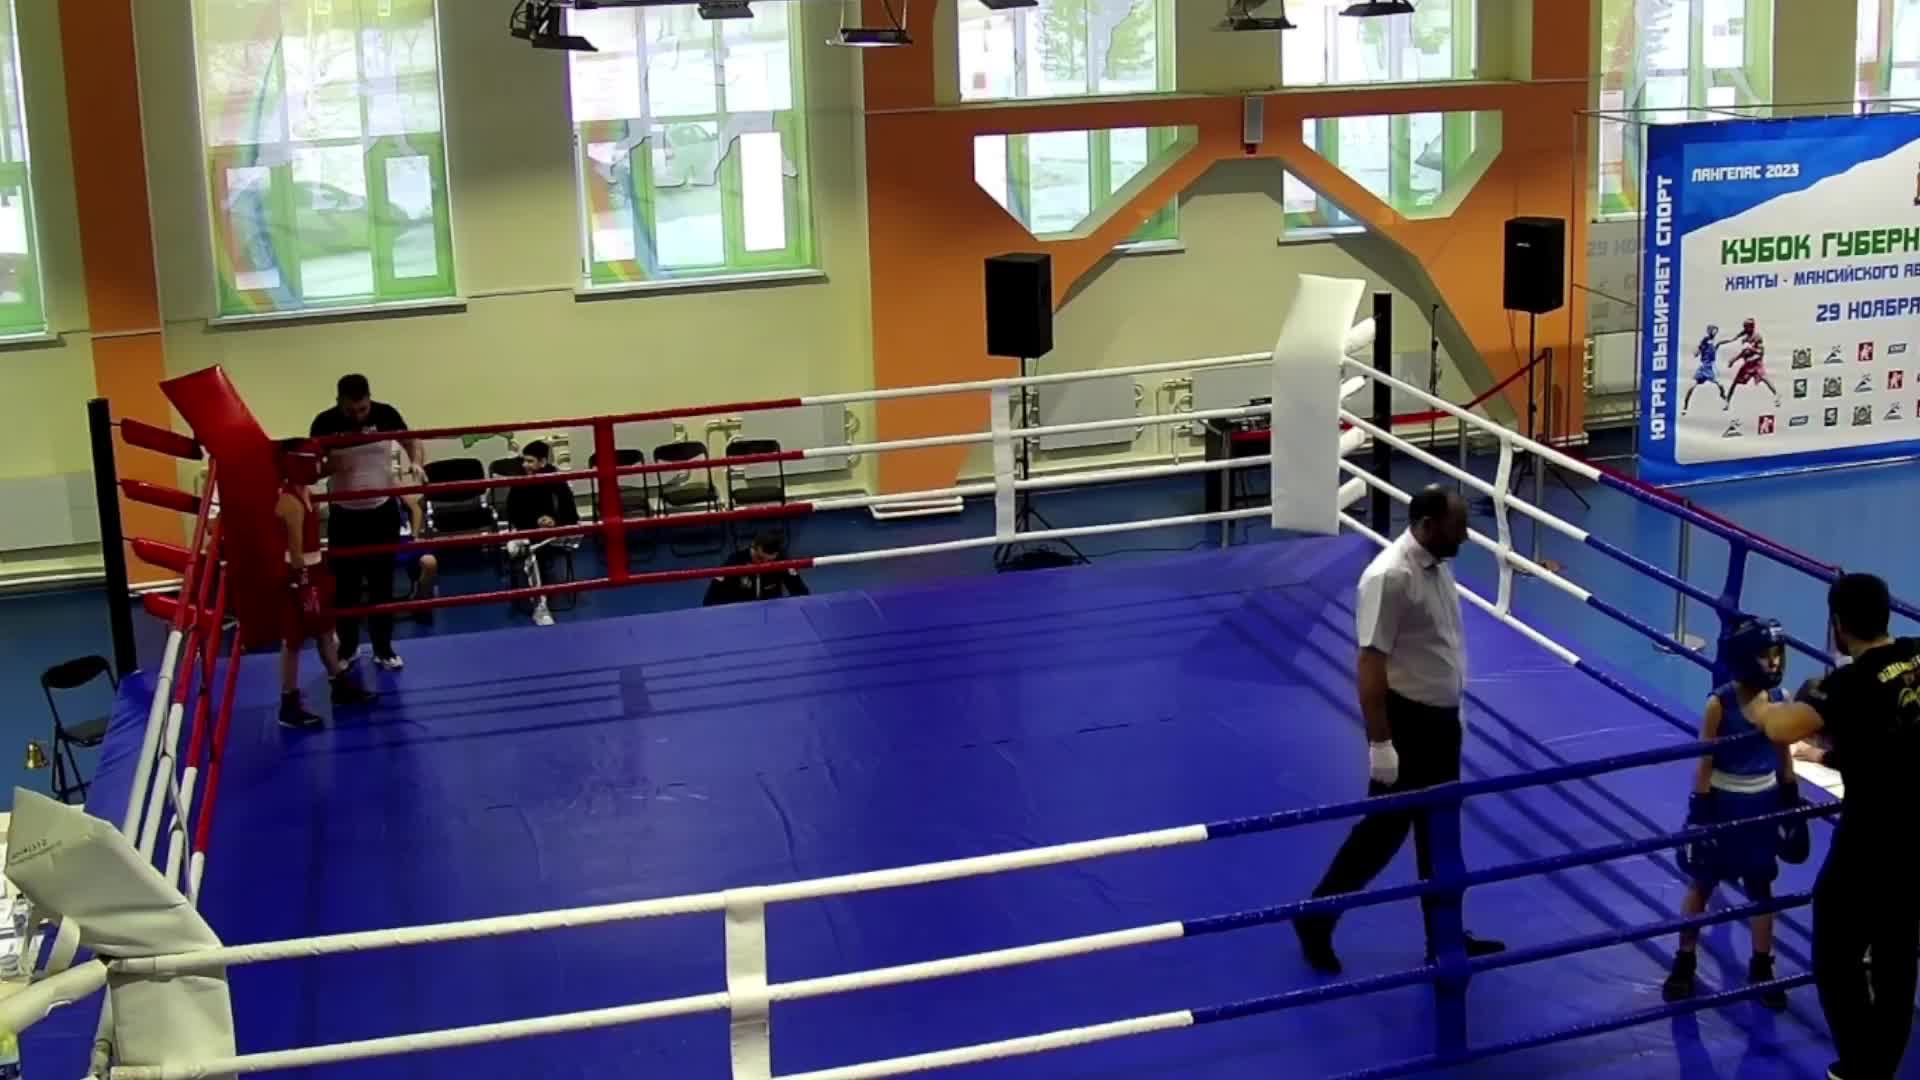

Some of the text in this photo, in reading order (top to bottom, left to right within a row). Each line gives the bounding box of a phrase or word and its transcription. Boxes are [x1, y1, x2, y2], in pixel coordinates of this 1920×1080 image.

[1691, 163, 1800, 182] ЛАНГЕПАС 2023
[1720, 227, 1920, 265] КУБОК ГУБЕРН
[1725, 273, 1779, 291] ХАНТЫ
[1793, 264, 1899, 286] МАНСИЙСКОГО
[1650, 175, 1673, 441] ЮГРА ВЫБИРАЕТ СПОРТ
[1816, 296, 1920, 322] 29 НОЯБРЯ
